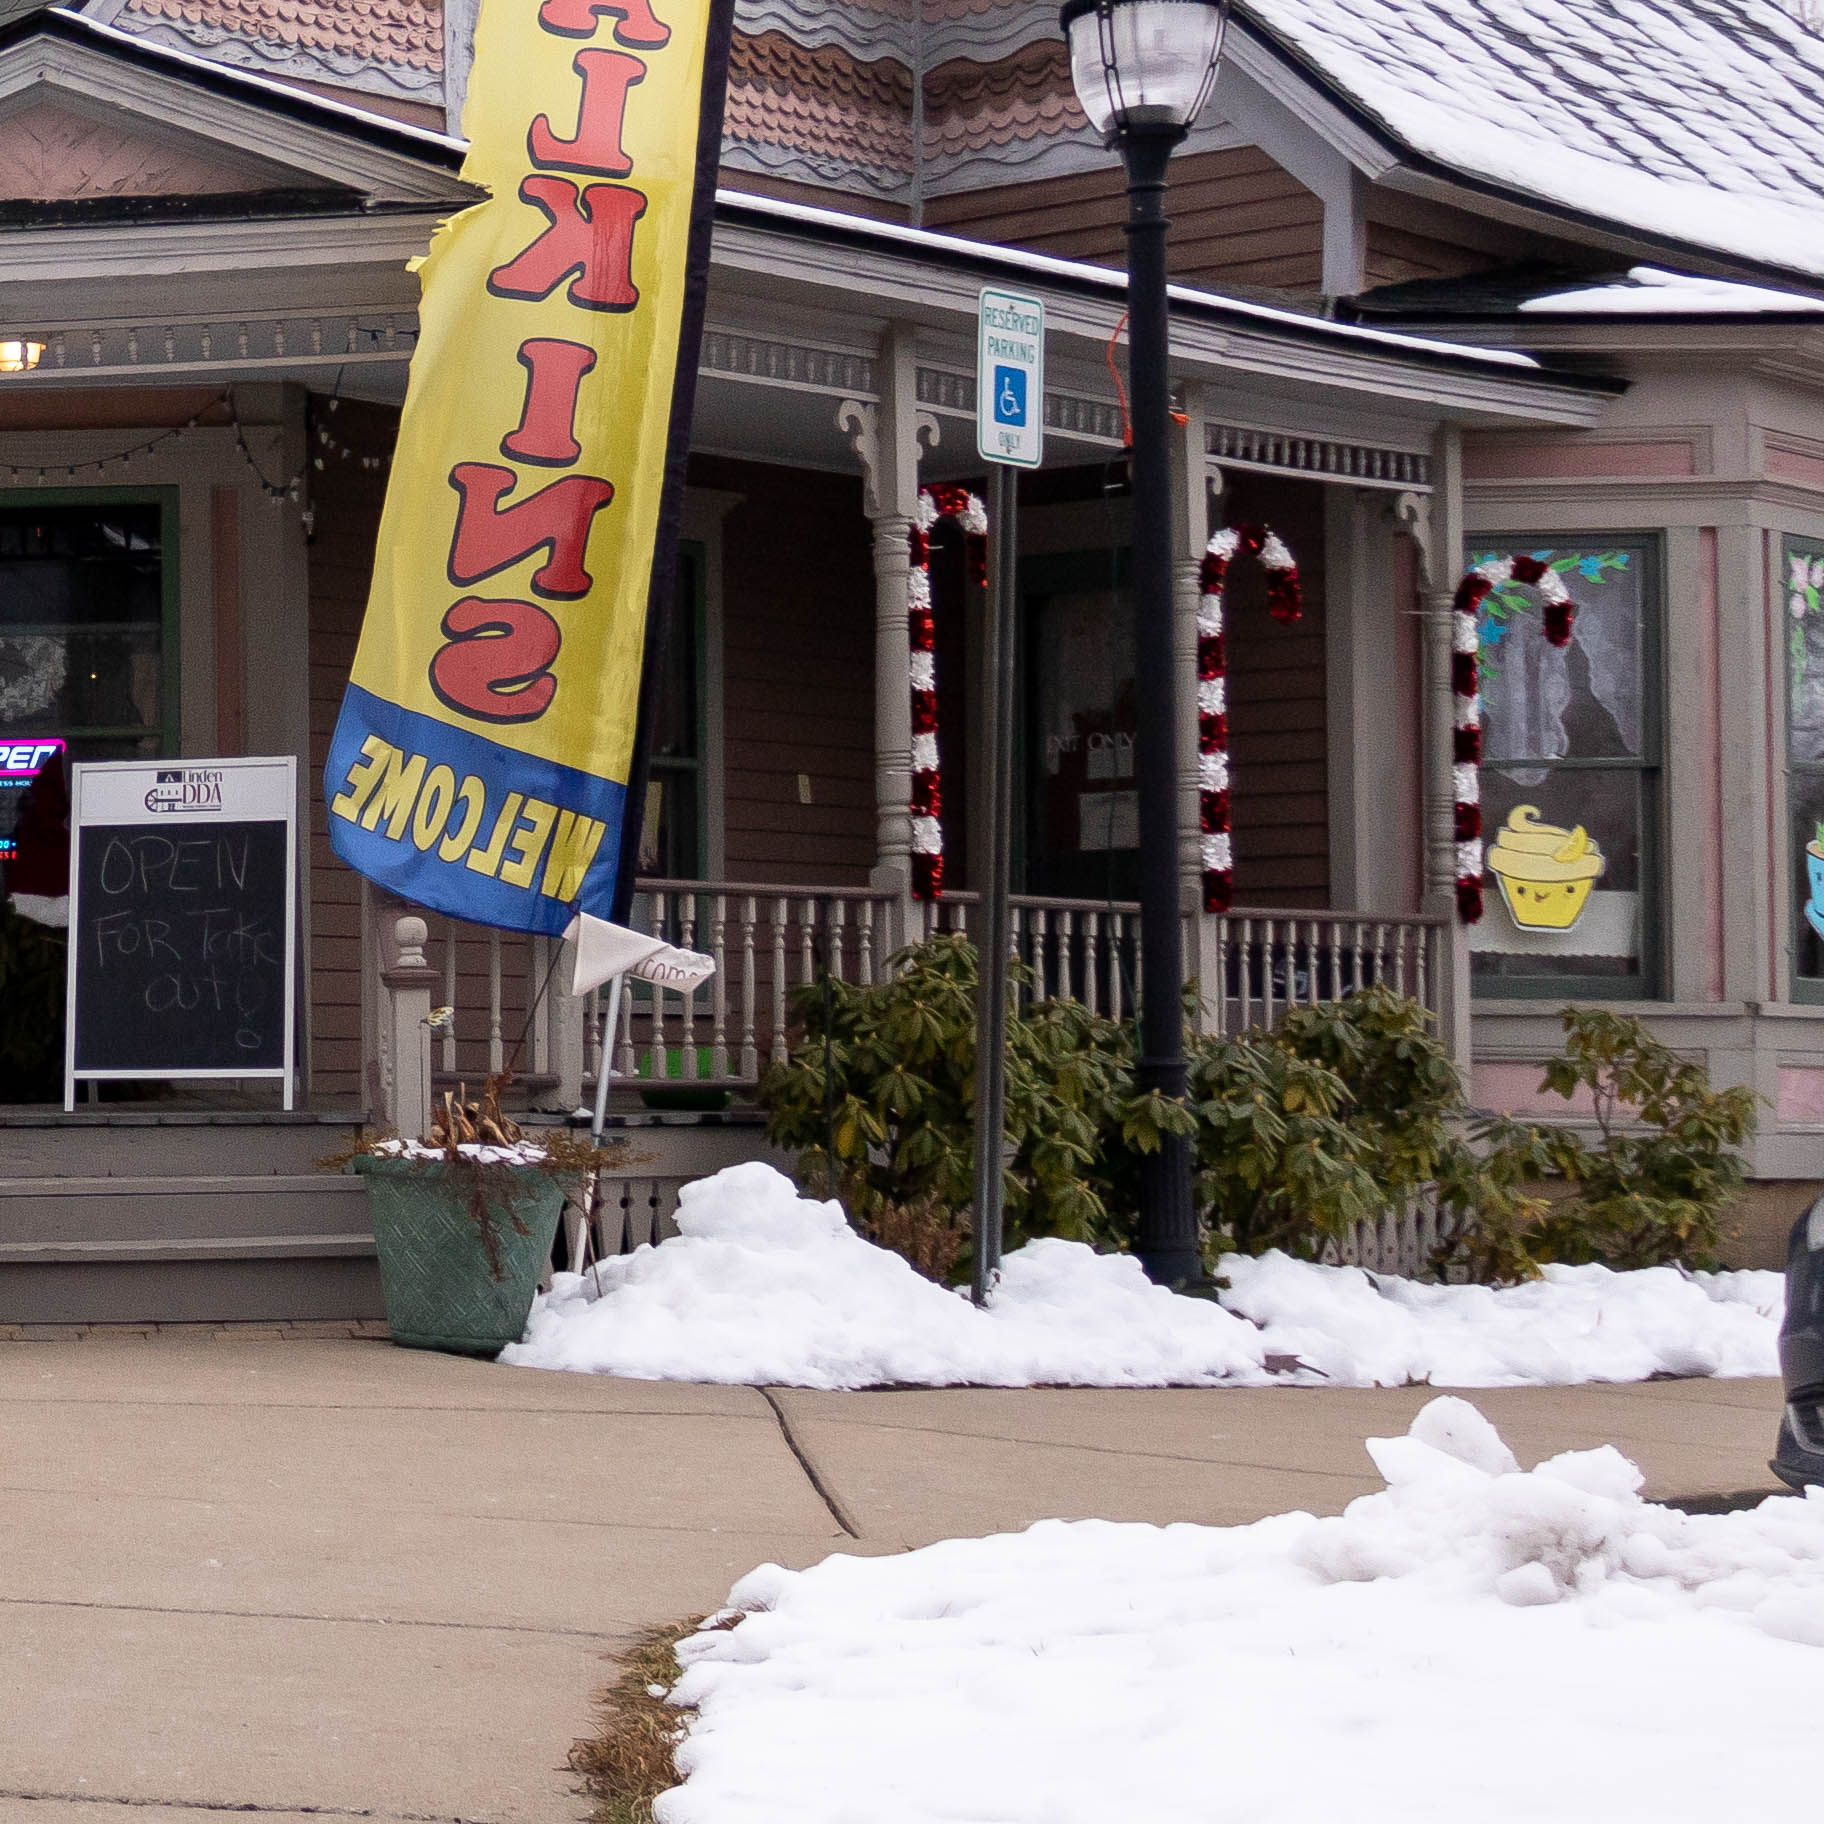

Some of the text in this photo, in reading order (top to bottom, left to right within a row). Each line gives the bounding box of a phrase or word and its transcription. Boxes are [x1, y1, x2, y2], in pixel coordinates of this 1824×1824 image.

[984, 306, 1039, 336] RESERVED
[988, 336, 1034, 363] PARKING
[999, 431, 1021, 449] ONLY
[15, 779, 32, 787] HOU
[182, 769, 223, 783] Linden
[182, 783, 222, 804] DDA
[102, 835, 249, 894] OPEN
[91, 910, 181, 967] FOR
